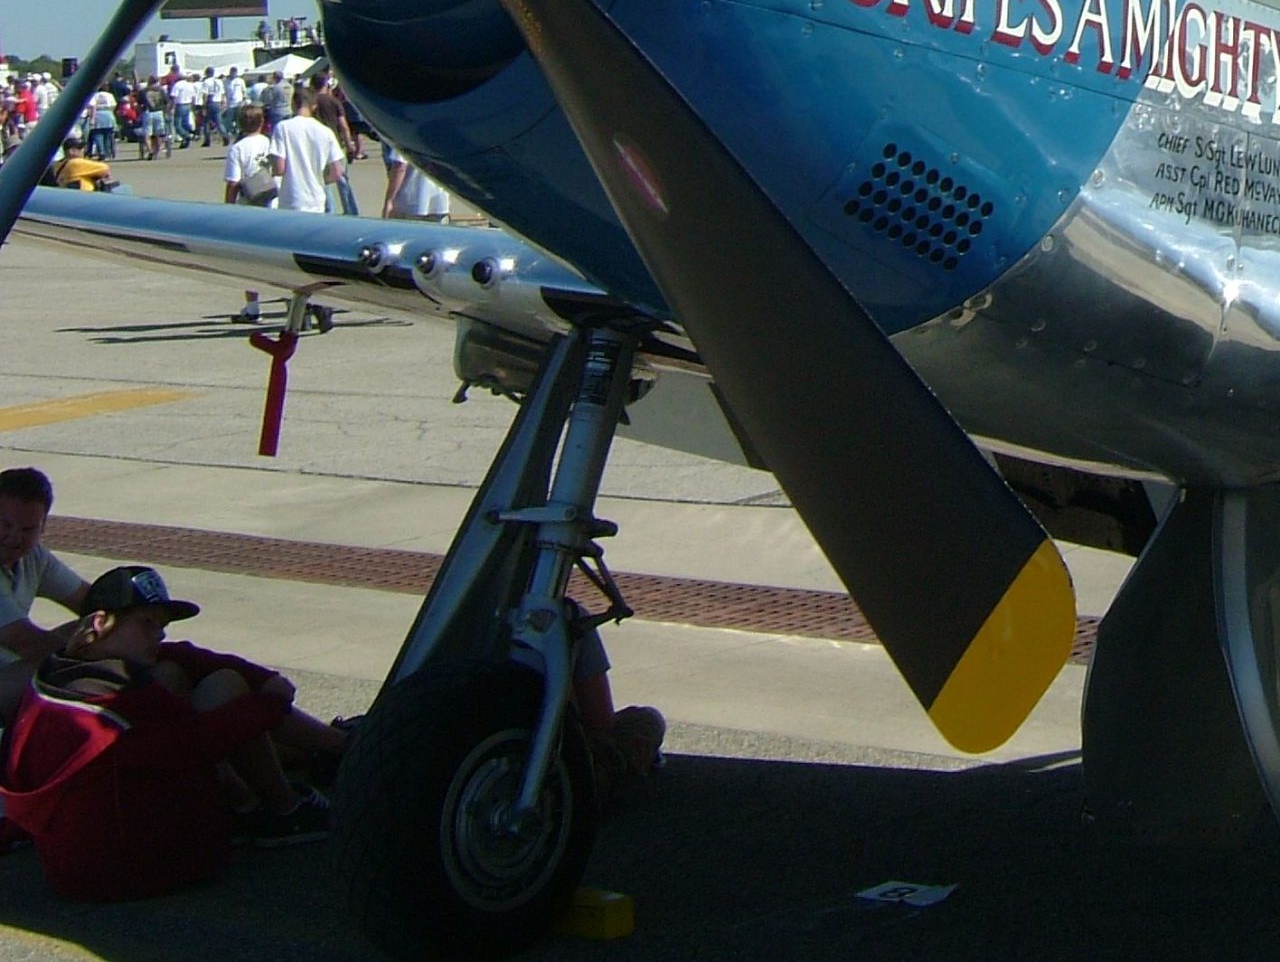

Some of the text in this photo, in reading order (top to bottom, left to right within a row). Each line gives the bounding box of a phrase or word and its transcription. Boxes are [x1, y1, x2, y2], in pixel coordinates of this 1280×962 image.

[1158, 133, 1191, 154] CHIEF
[1155, 163, 1187, 183] ASST
[1214, 171, 1240, 196] RED
[1175, 192, 1198, 226] Sgt
